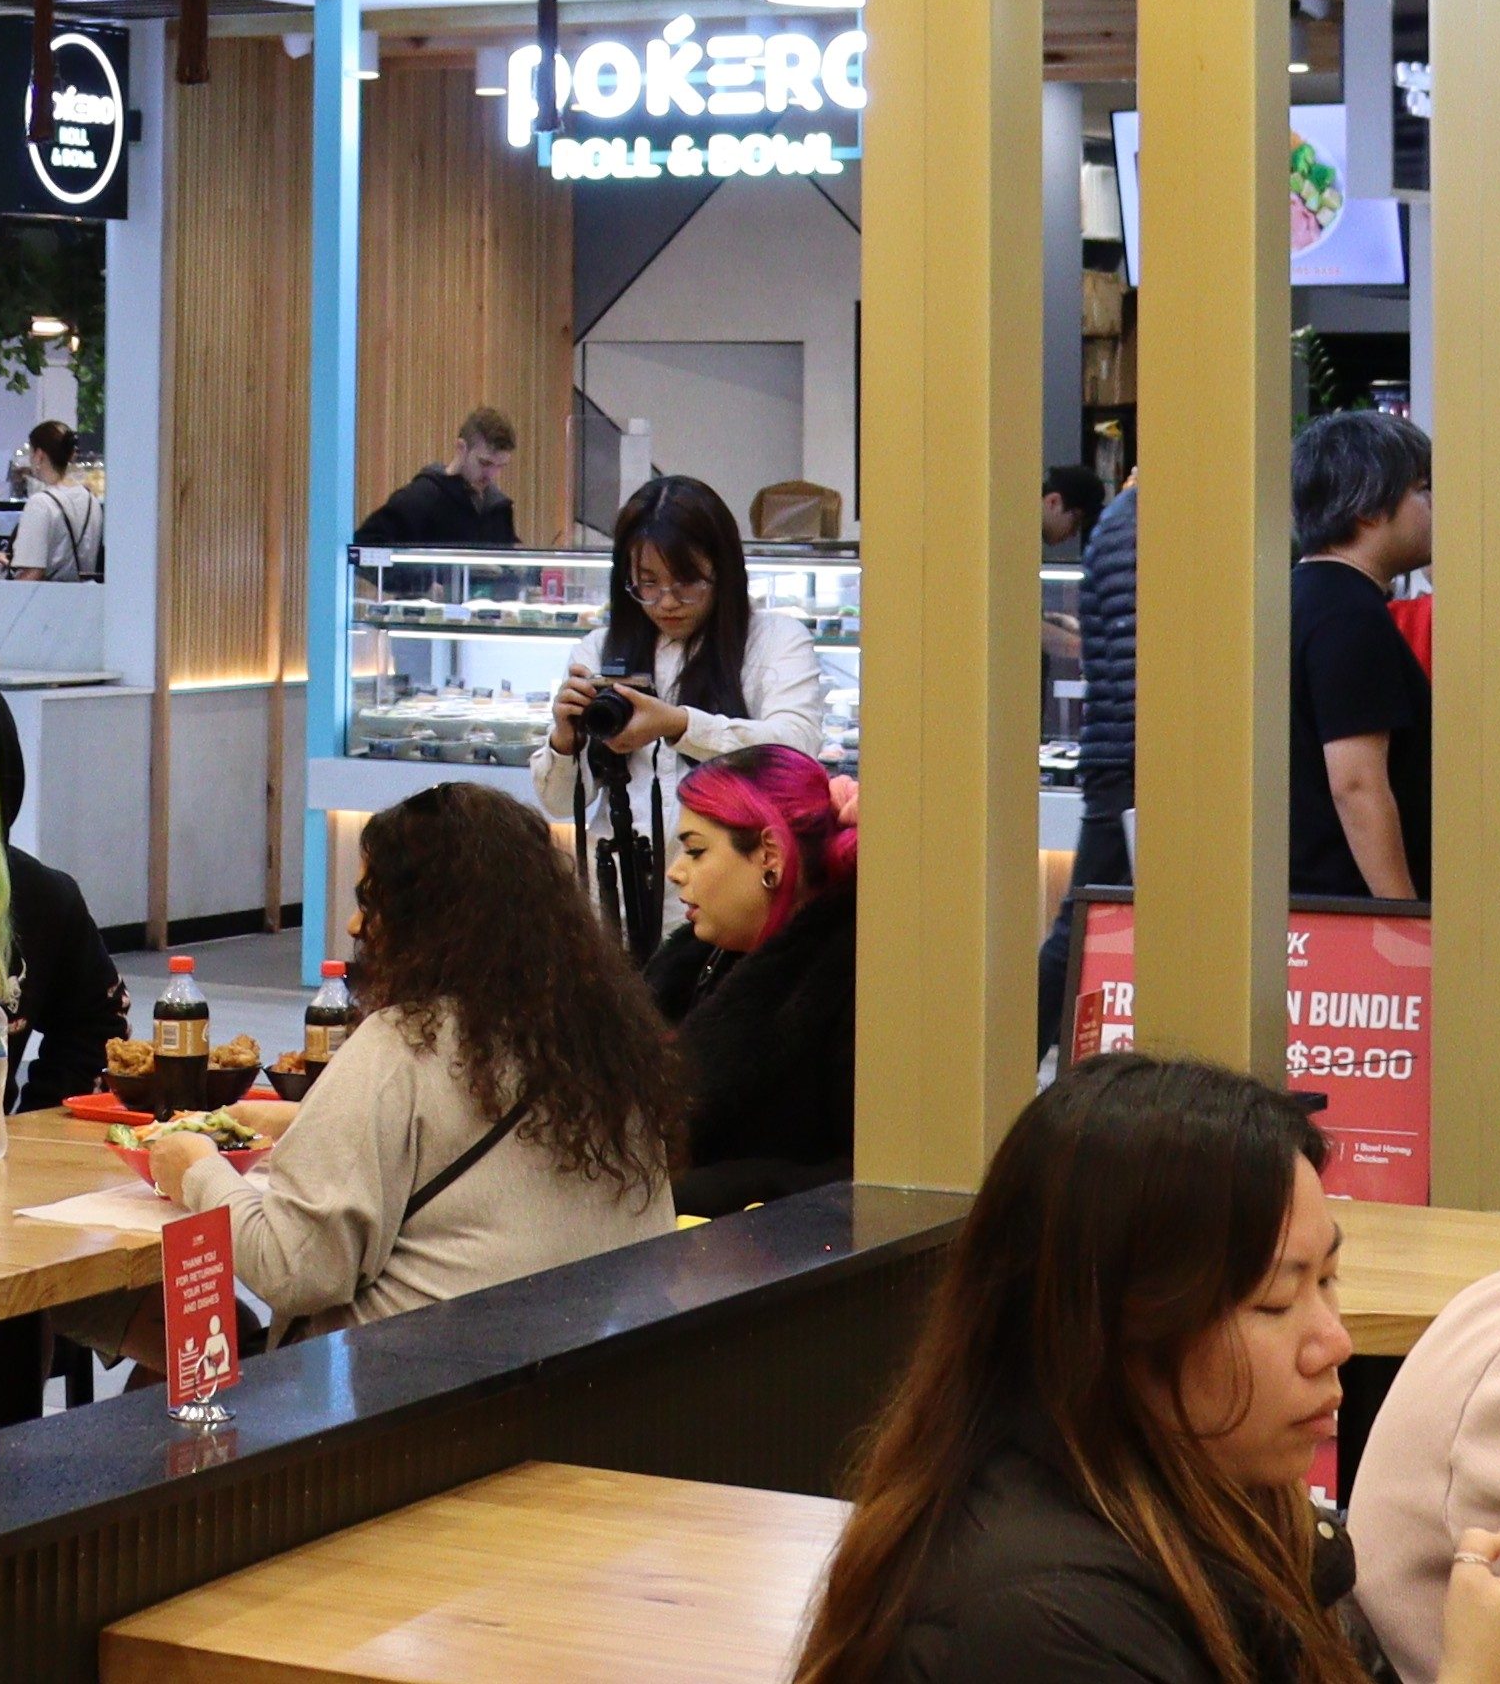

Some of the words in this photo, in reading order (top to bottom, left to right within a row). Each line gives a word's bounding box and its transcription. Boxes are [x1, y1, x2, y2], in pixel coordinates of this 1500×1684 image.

[551, 135, 662, 180] ROLL
[667, 134, 703, 177] &
[708, 133, 844, 176] BOWL
[1309, 991, 1422, 1031] BUNDLE
[1287, 1040, 1414, 1080] $33.00
[1353, 1154, 1389, 1164] Chicken
[1360, 1142, 1381, 1153] Bowl
[1383, 1144, 1411, 1157] Honey
[182, 1254, 203, 1270] THANK
[204, 1250, 217, 1264] YOU
[176, 1273, 189, 1288] FOR
[189, 1262, 224, 1284] RETURNING
[183, 1284, 201, 1300] YOUR
